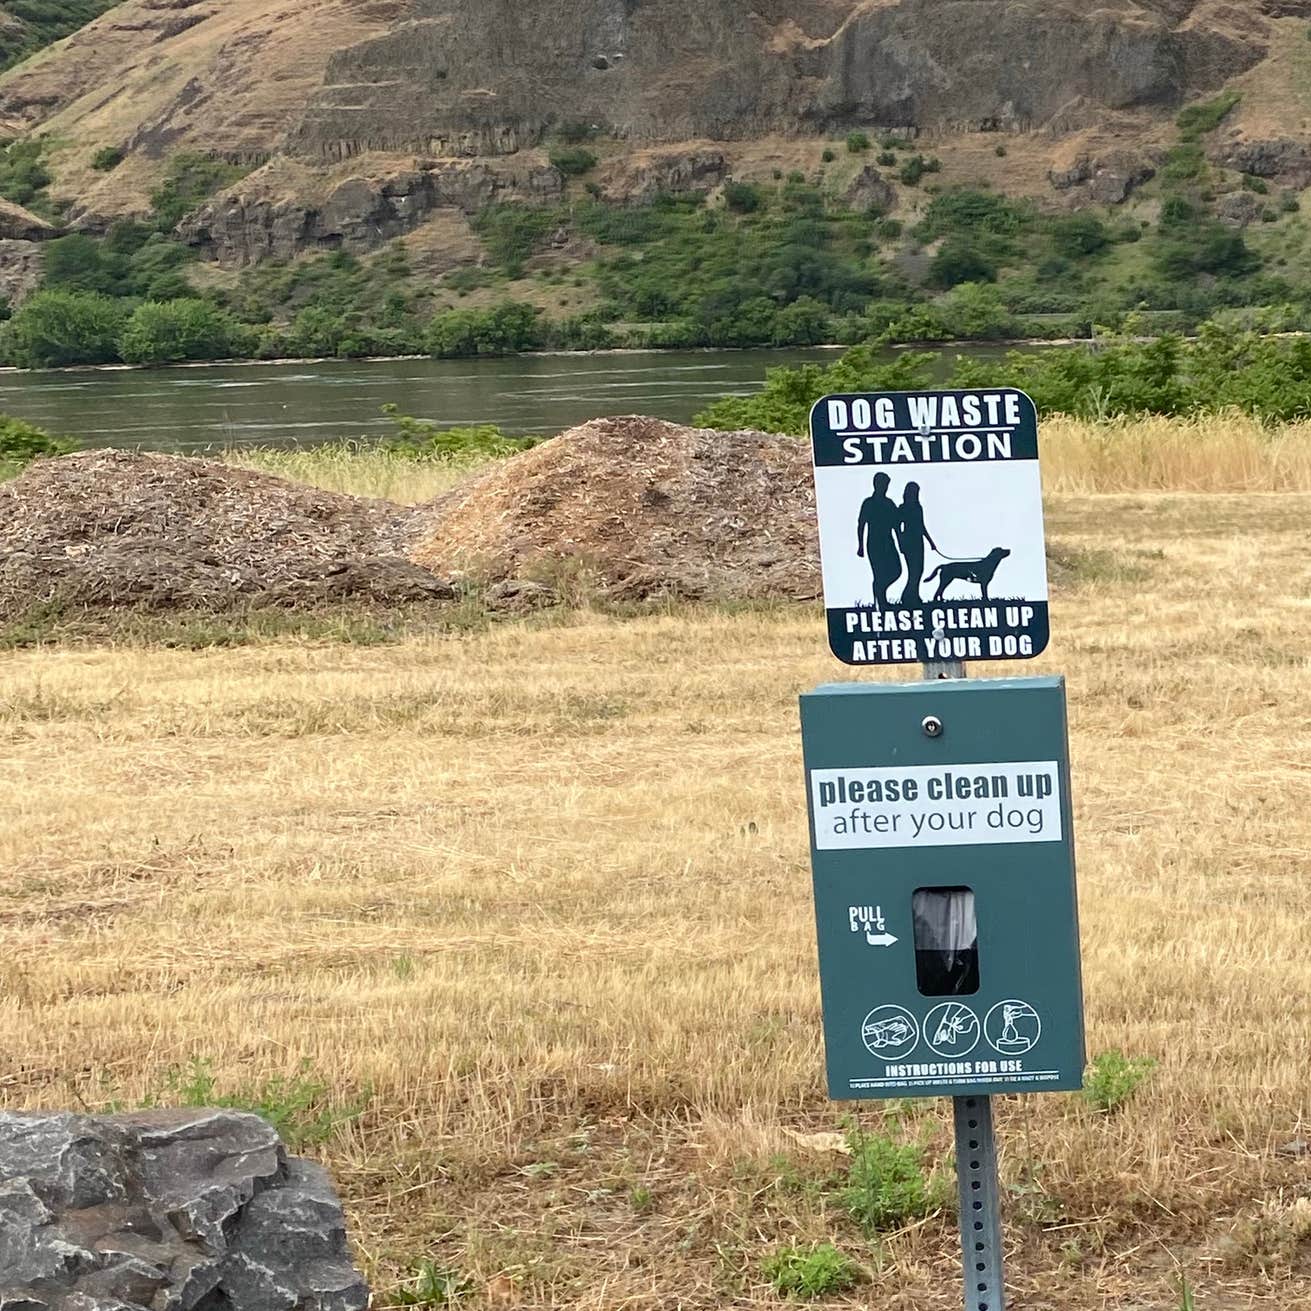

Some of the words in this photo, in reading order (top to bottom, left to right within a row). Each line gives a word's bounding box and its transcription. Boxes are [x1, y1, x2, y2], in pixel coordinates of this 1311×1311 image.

[827, 397, 895, 430] DOG
[907, 394, 1021, 428] WASTE
[843, 433, 1012, 463] STATION
[846, 611, 924, 632] PLEASE
[932, 607, 998, 629] CLEAN
[1006, 607, 1033, 626] UP
[853, 639, 917, 661] AFTER
[925, 636, 981, 658] YOUR
[990, 635, 1032, 655] DOG
[819, 774, 918, 807] please
[927, 772, 1008, 800] clean
[1018, 772, 1052, 800] up
[833, 808, 901, 834] after
[911, 808, 977, 838] your
[987, 803, 1044, 833] dog
[849, 906, 884, 922] PULL
[851, 921, 884, 931] BAG
[885, 1062, 972, 1077] INSTRUCTIONS
[975, 1061, 997, 1073] FOR
[1000, 1060, 1022, 1072] USE
